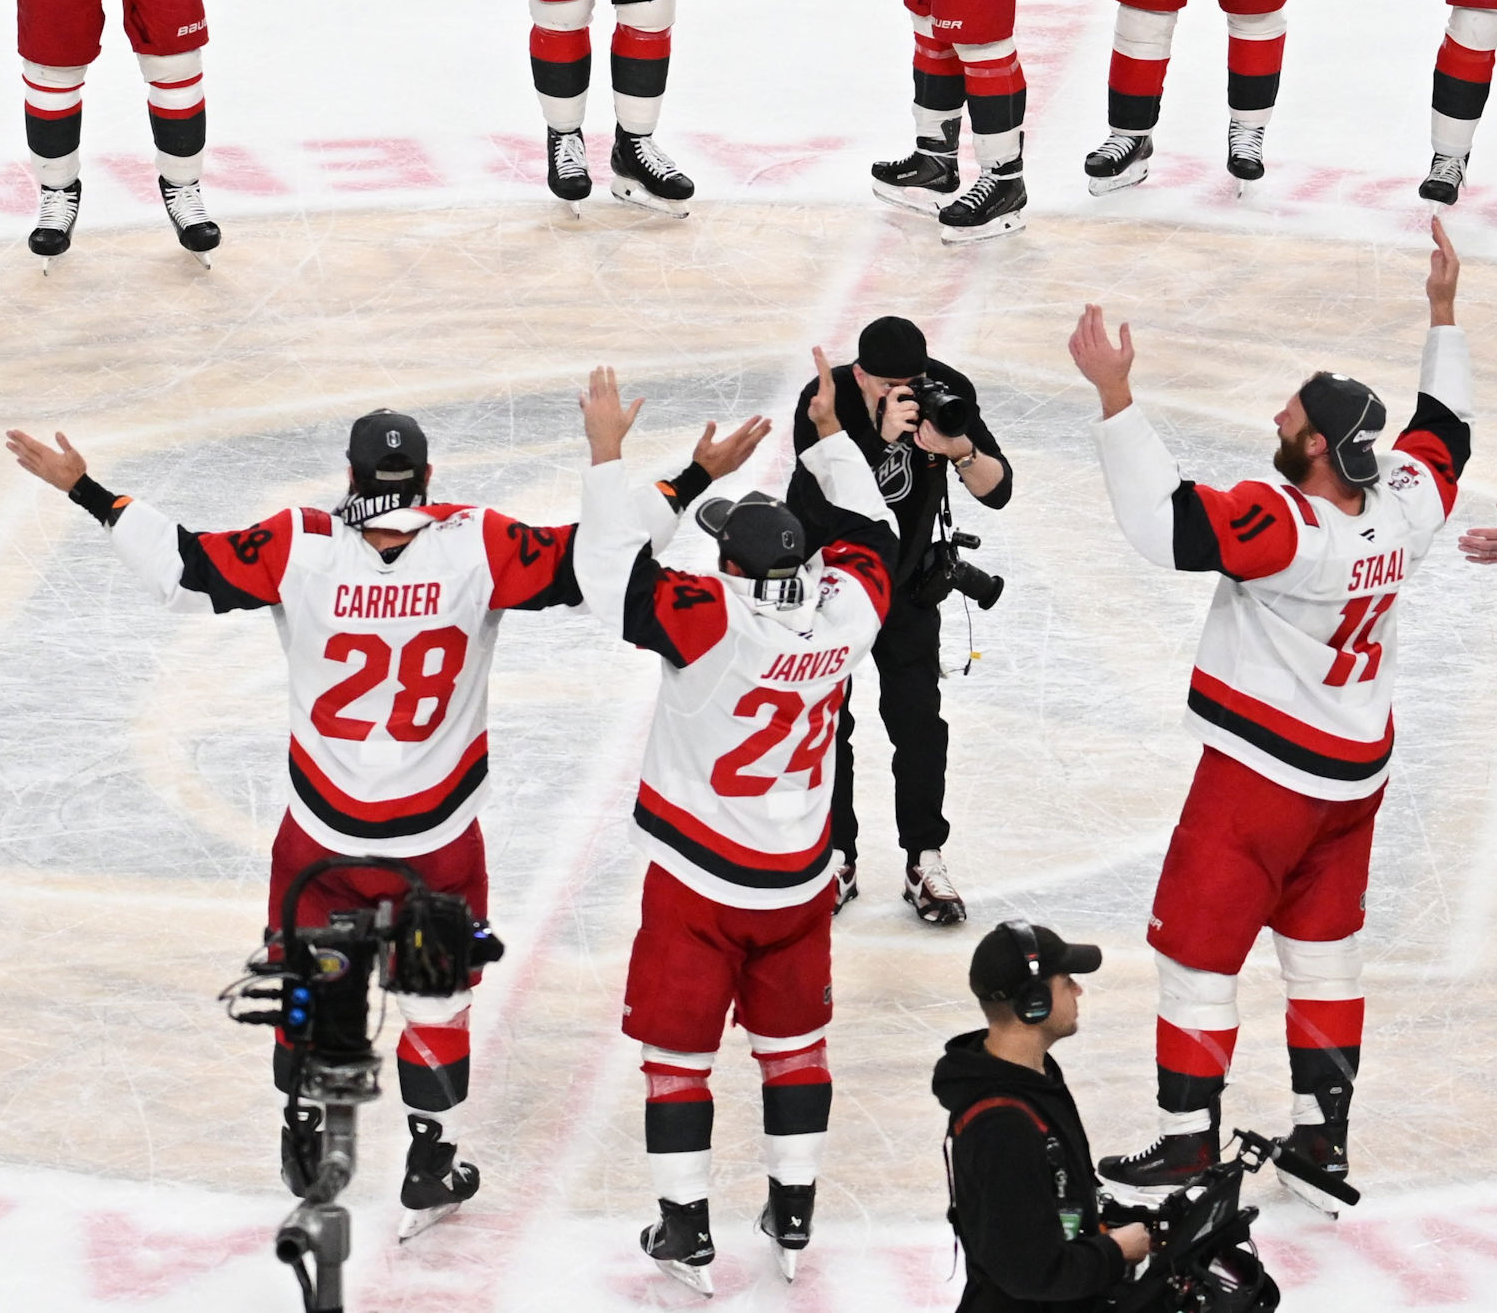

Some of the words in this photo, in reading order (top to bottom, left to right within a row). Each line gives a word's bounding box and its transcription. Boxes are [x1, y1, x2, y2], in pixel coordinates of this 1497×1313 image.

[177, 18, 208, 37] BAU
[1230, 504, 1277, 543] 11
[1347, 548, 1405, 592] STAAL
[334, 581, 441, 618] CARRIER
[310, 624, 469, 743] 28
[760, 646, 849, 682] JARVIS
[709, 678, 846, 798] 24
